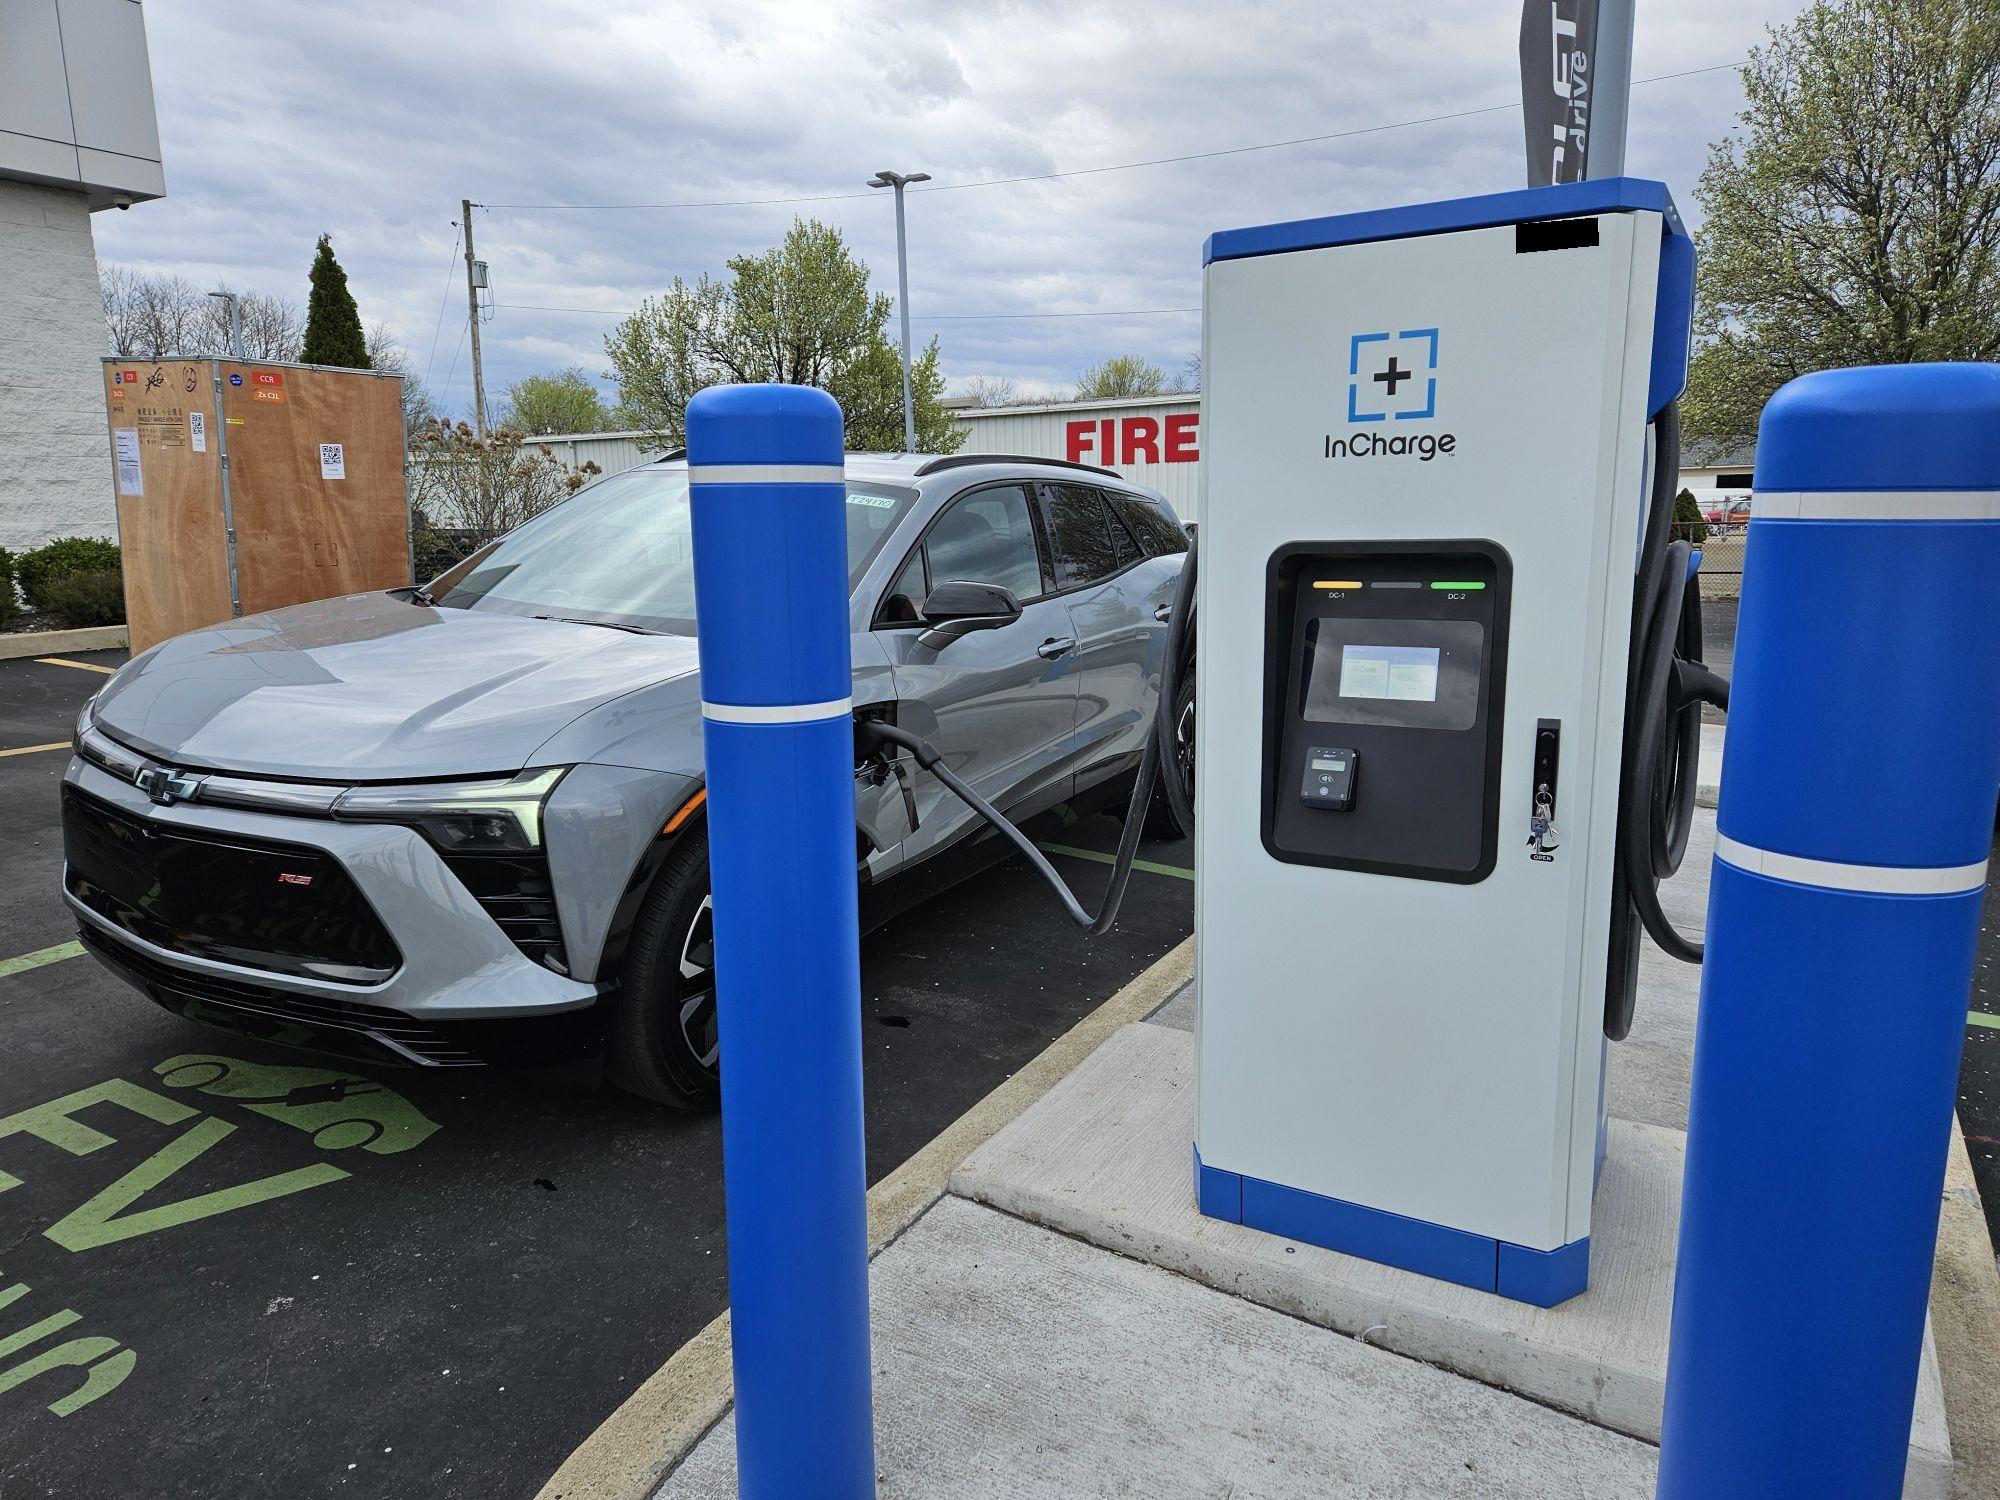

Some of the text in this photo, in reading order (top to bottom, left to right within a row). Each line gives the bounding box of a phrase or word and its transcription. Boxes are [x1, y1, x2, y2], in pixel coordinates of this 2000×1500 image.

[1569, 50, 1588, 152] drive
[259, 375, 275, 383] CCR
[1066, 413, 1200, 467] FIRE
[1324, 432, 1457, 462] InCharge
[277, 873, 313, 885] RS
